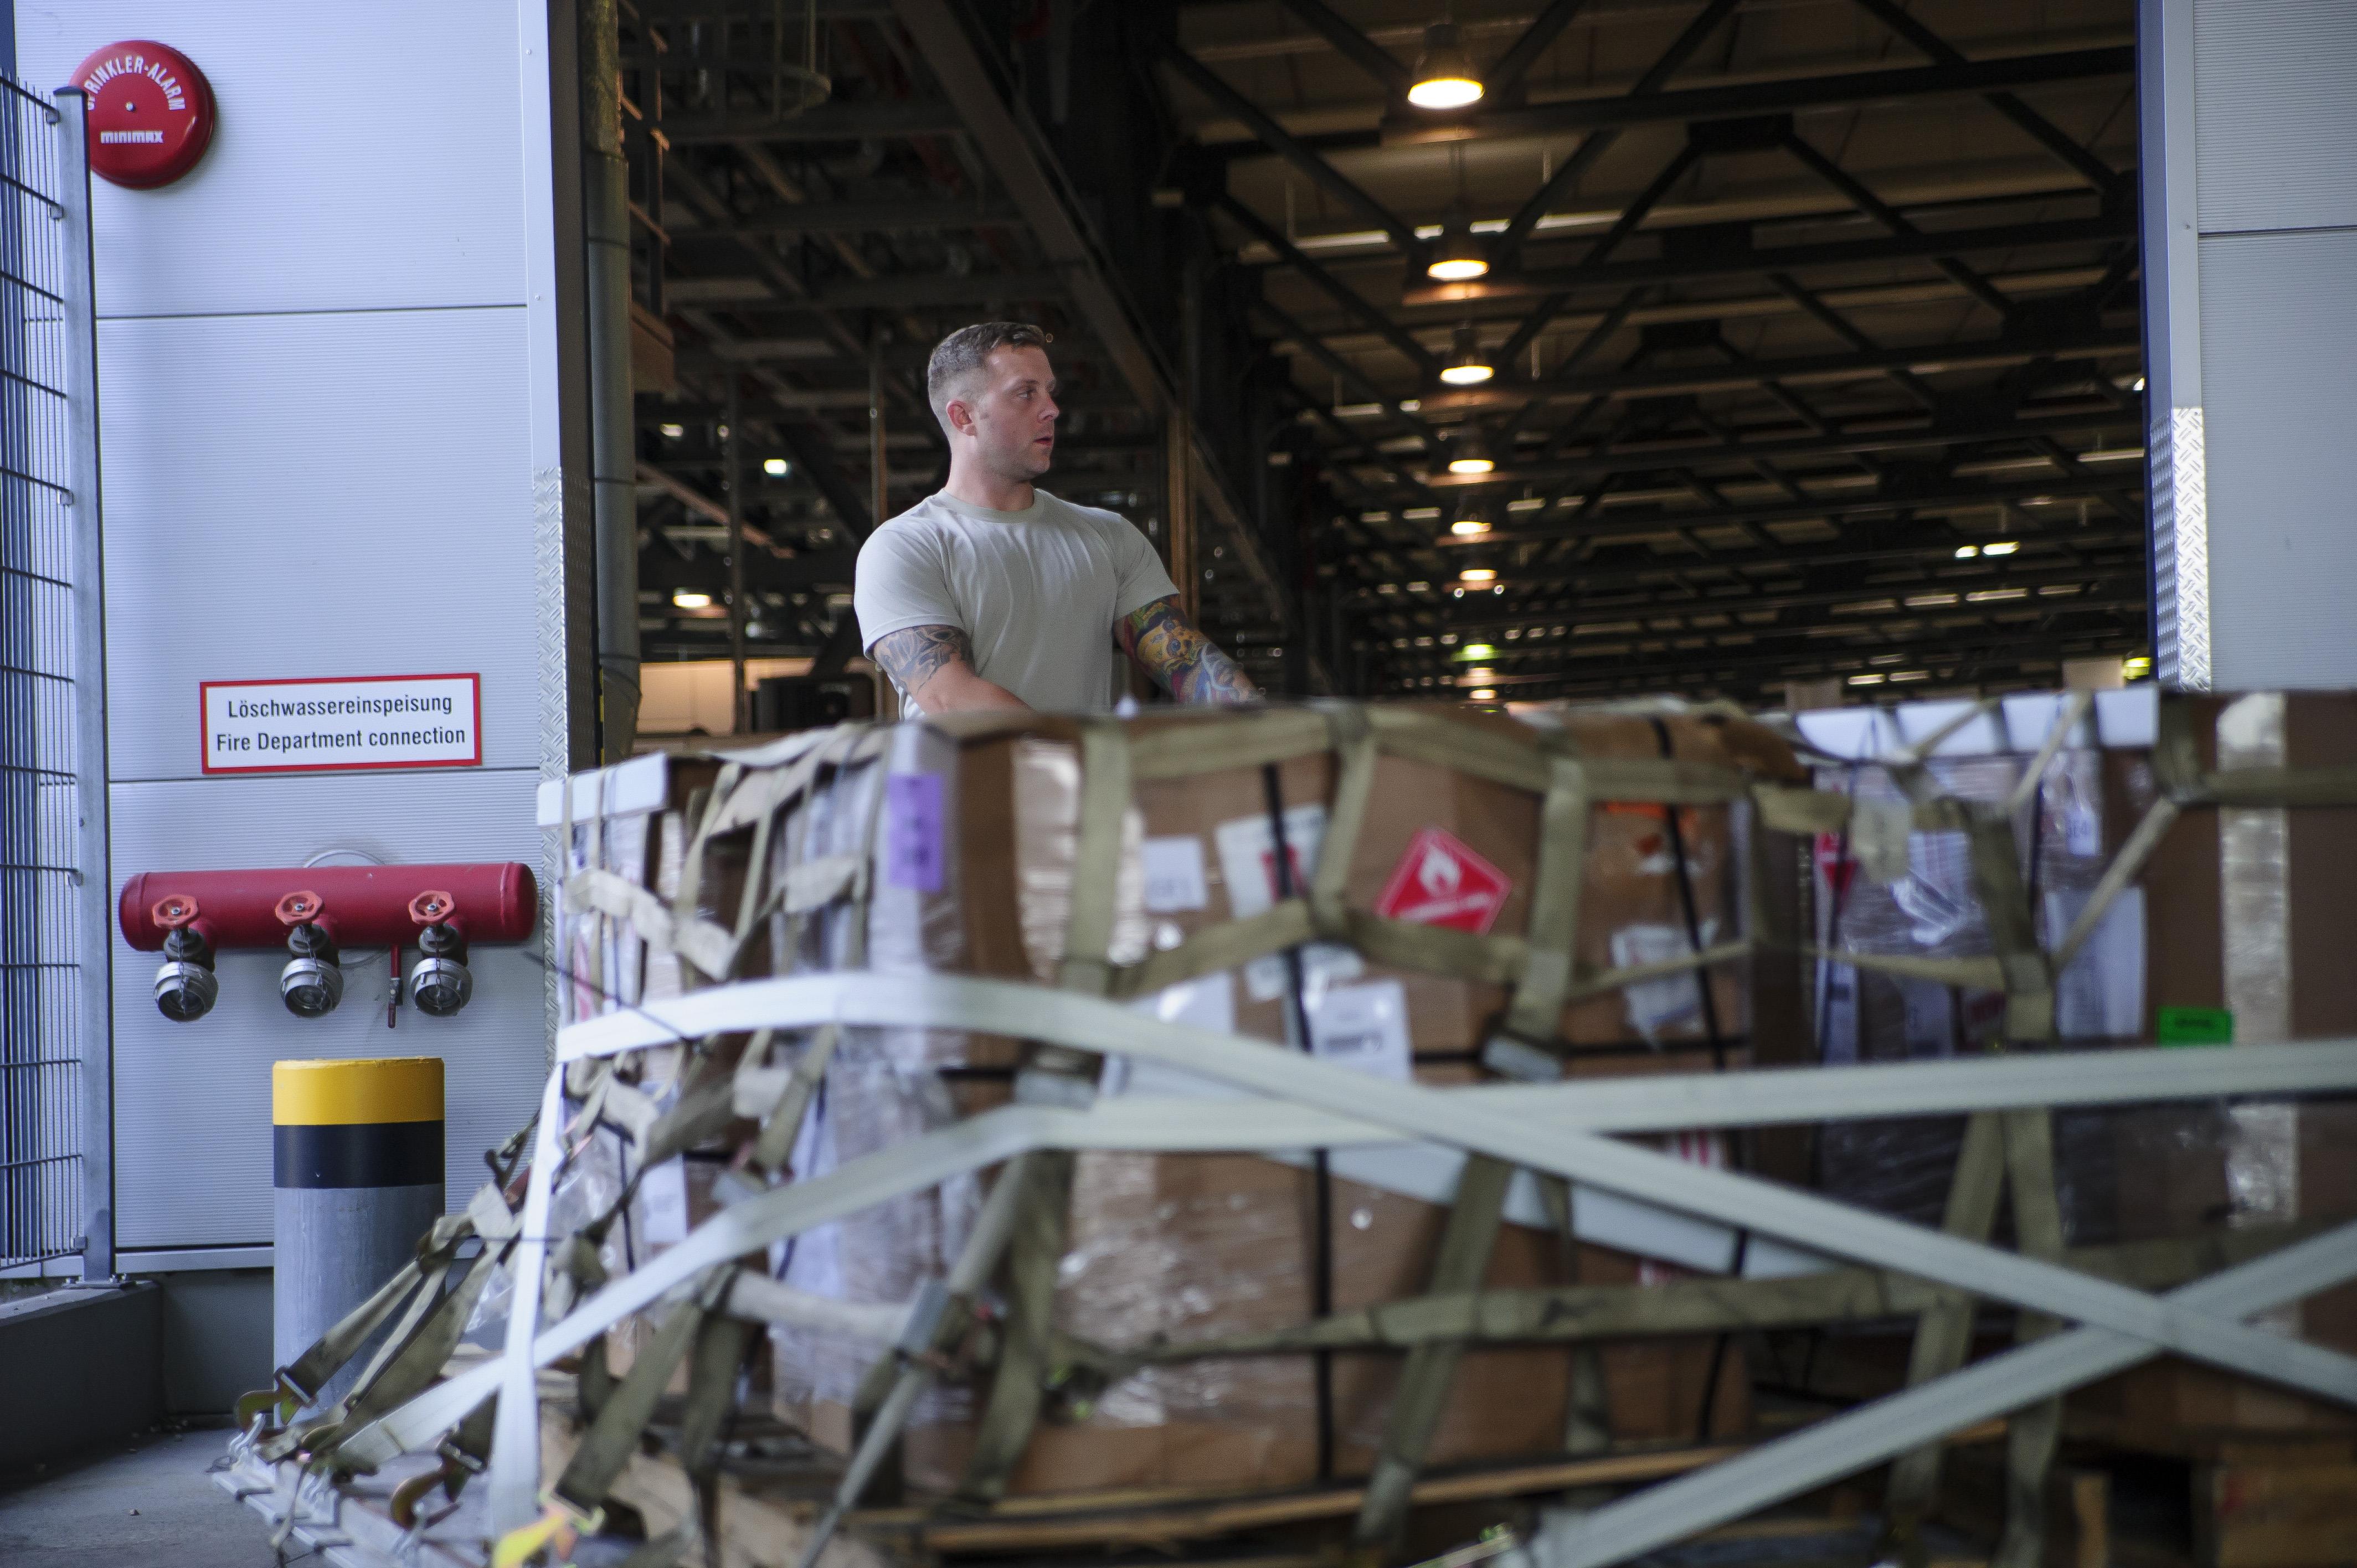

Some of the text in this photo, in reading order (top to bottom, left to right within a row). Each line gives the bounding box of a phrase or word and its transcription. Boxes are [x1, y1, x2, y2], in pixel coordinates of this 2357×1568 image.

[228, 694, 452, 718] Löschwassereinspeisung
[217, 726, 465, 753] Fire Department connection
